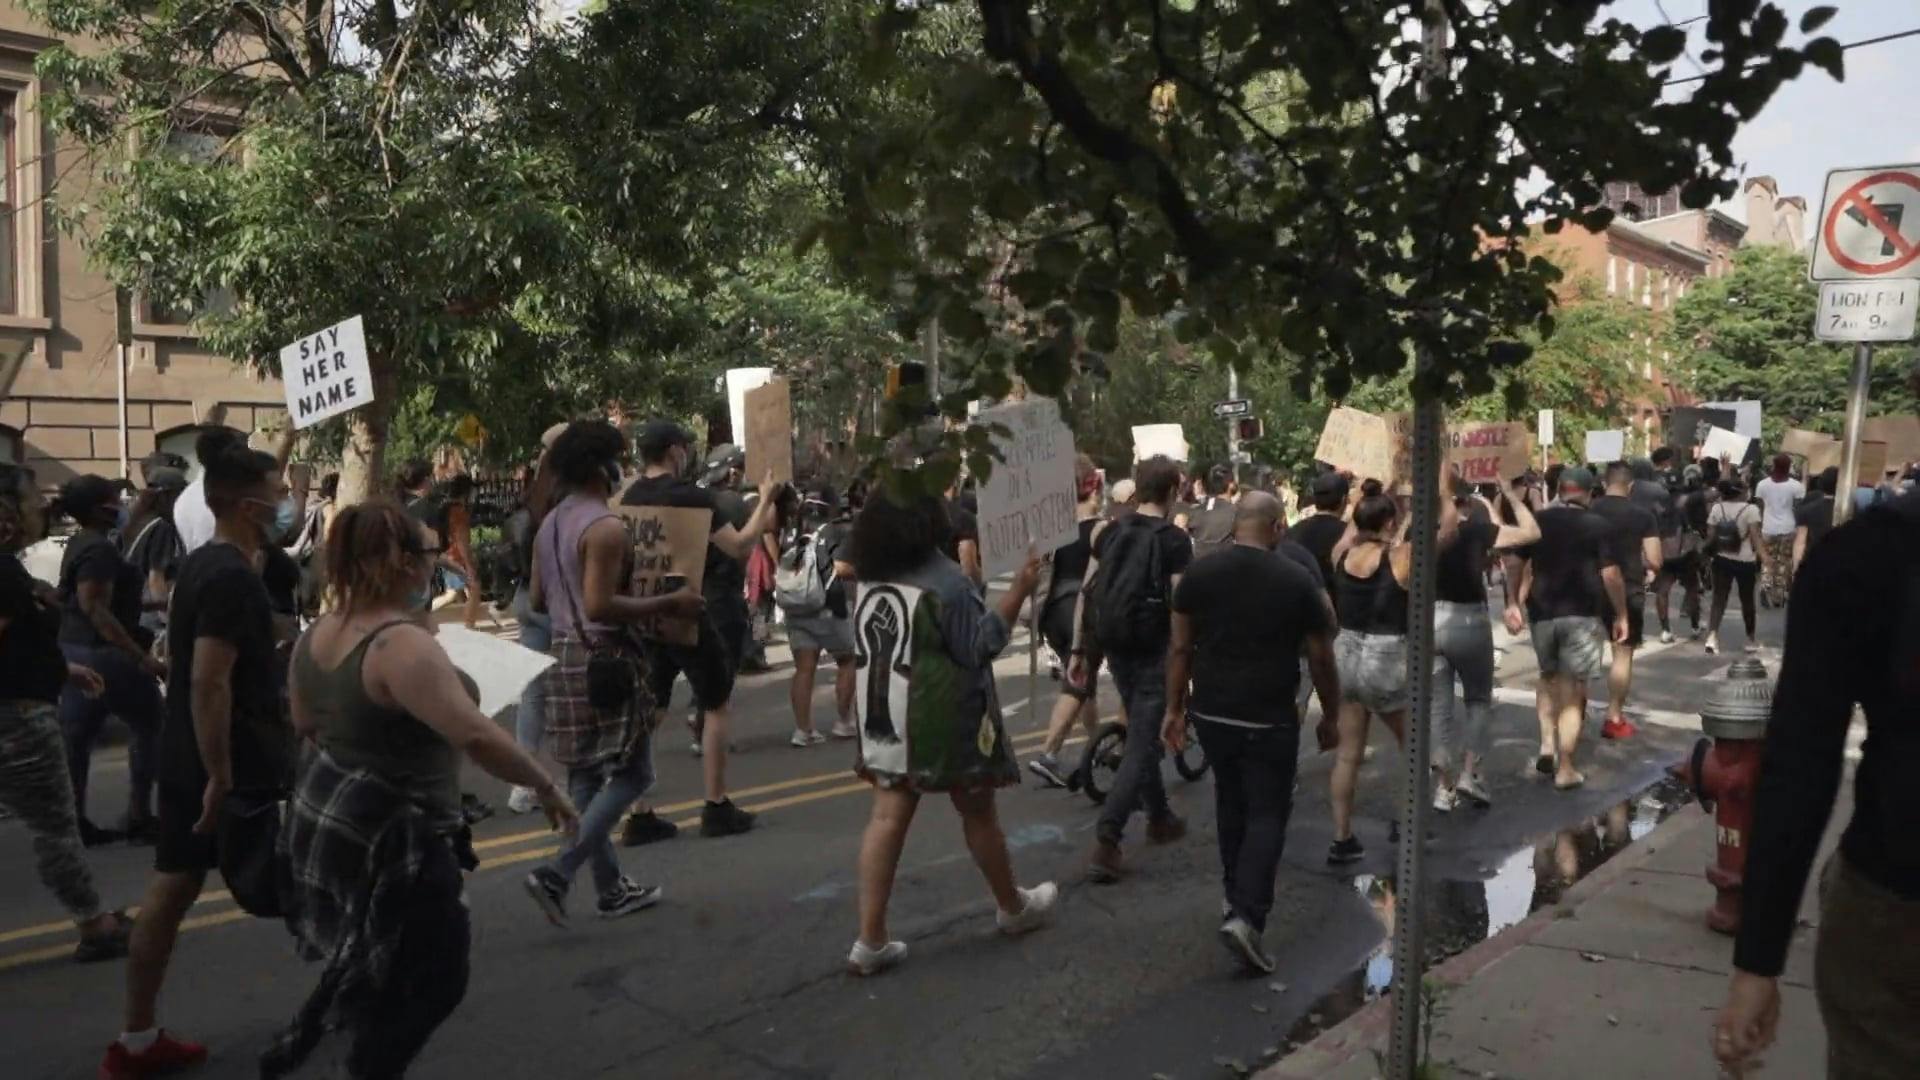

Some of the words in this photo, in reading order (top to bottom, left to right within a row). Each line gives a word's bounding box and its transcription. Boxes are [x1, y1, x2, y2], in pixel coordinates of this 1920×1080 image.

[1876, 291, 1904, 307] FI
[300, 326, 339, 360] SAY
[302, 351, 347, 386] HER
[298, 377, 356, 418] NAME
